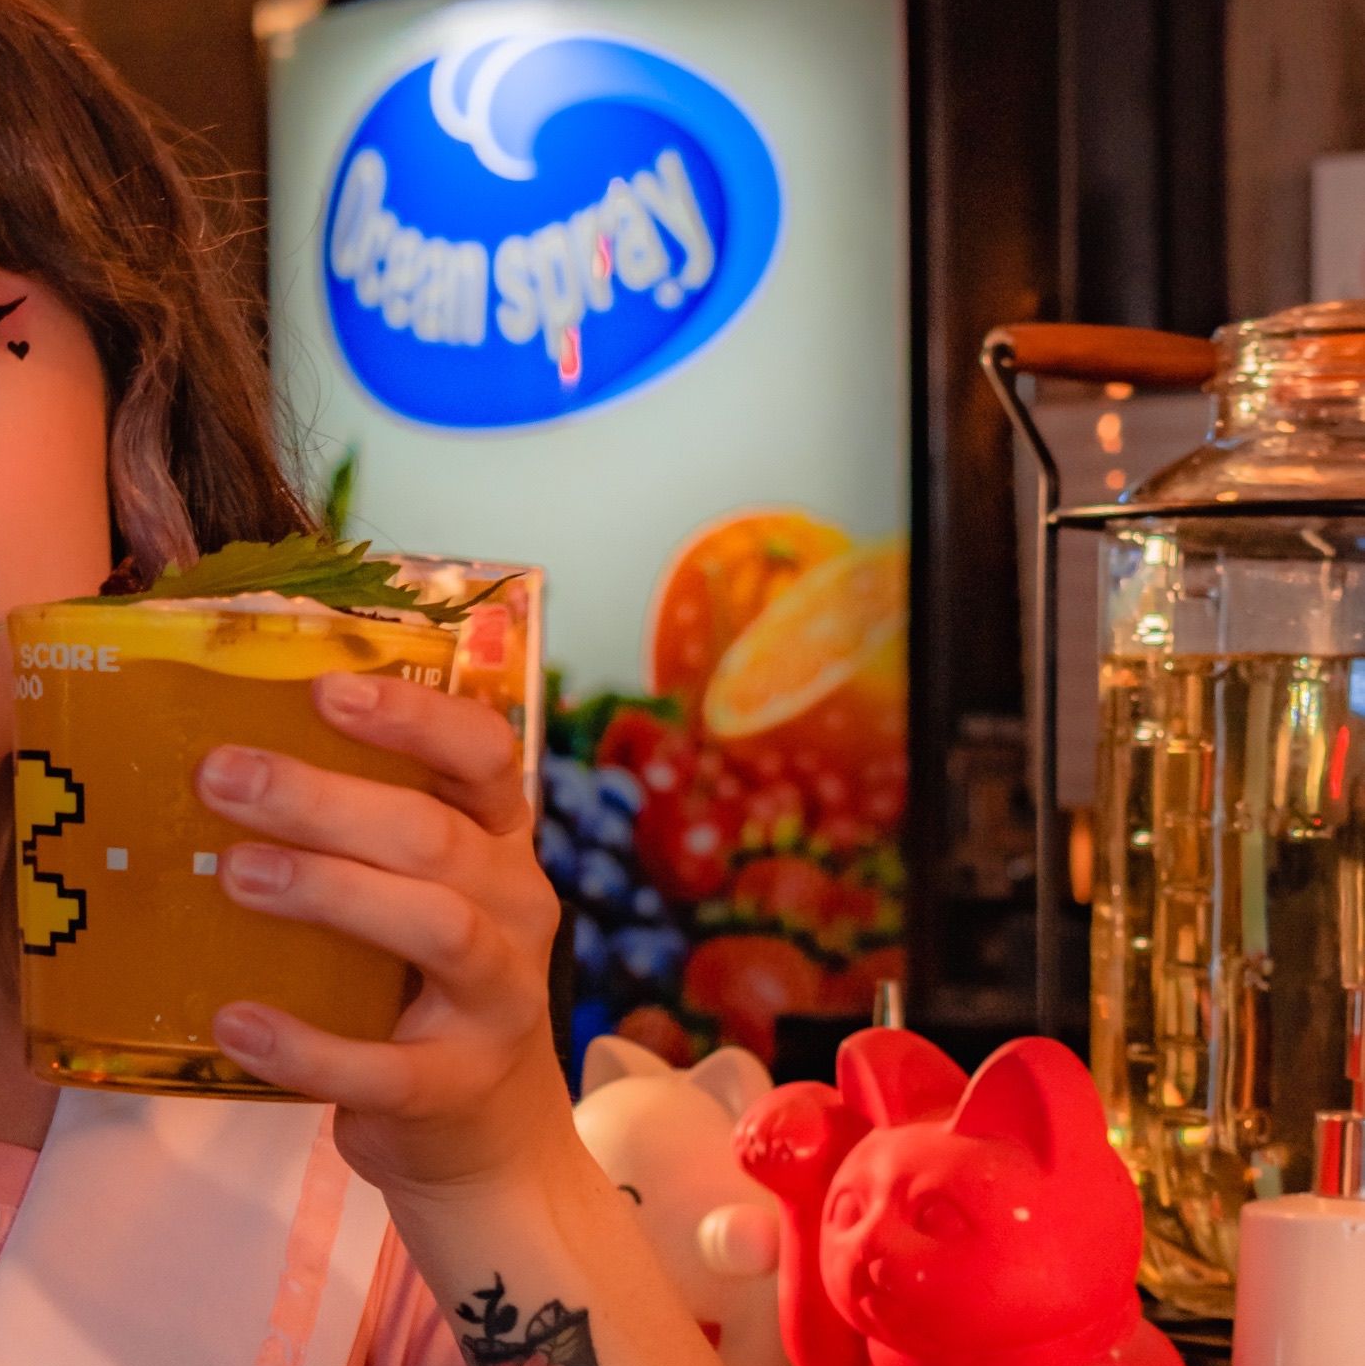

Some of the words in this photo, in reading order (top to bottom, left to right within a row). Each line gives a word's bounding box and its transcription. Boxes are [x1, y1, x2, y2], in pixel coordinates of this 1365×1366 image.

[331, 148, 488, 347] Ocean
[493, 149, 715, 382] spray
[21, 641, 121, 672] SCORE
